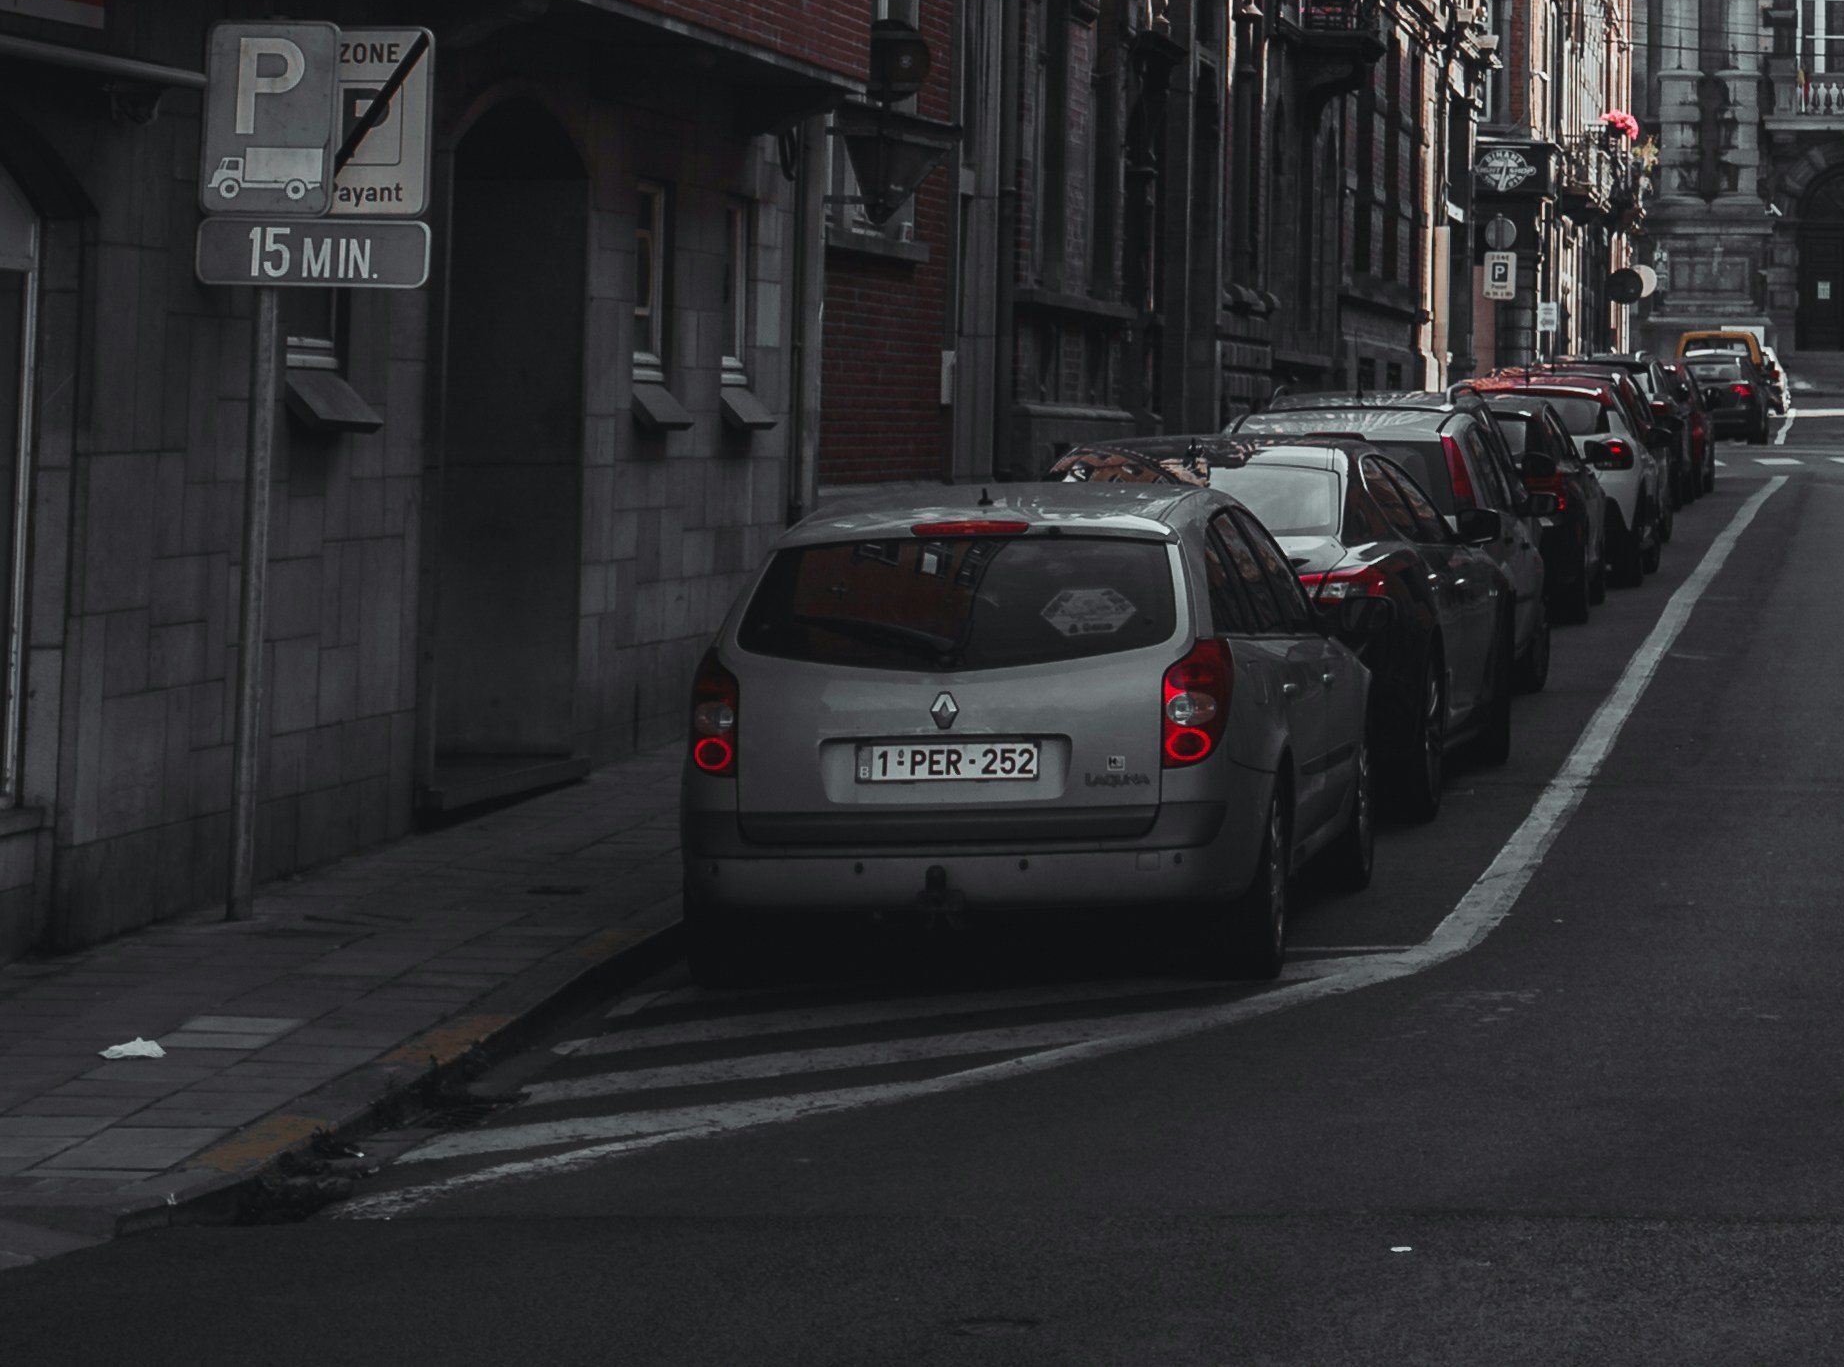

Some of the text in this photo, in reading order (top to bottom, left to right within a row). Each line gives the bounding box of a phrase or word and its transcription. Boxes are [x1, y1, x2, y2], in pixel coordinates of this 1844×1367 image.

[340, 43, 400, 64] ZONE
[235, 37, 306, 134] P
[1485, 151, 1523, 164] DINANT
[248, 227, 378, 279] 15 MIN.
[1494, 265, 1505, 280] P
[860, 766, 870, 778] B
